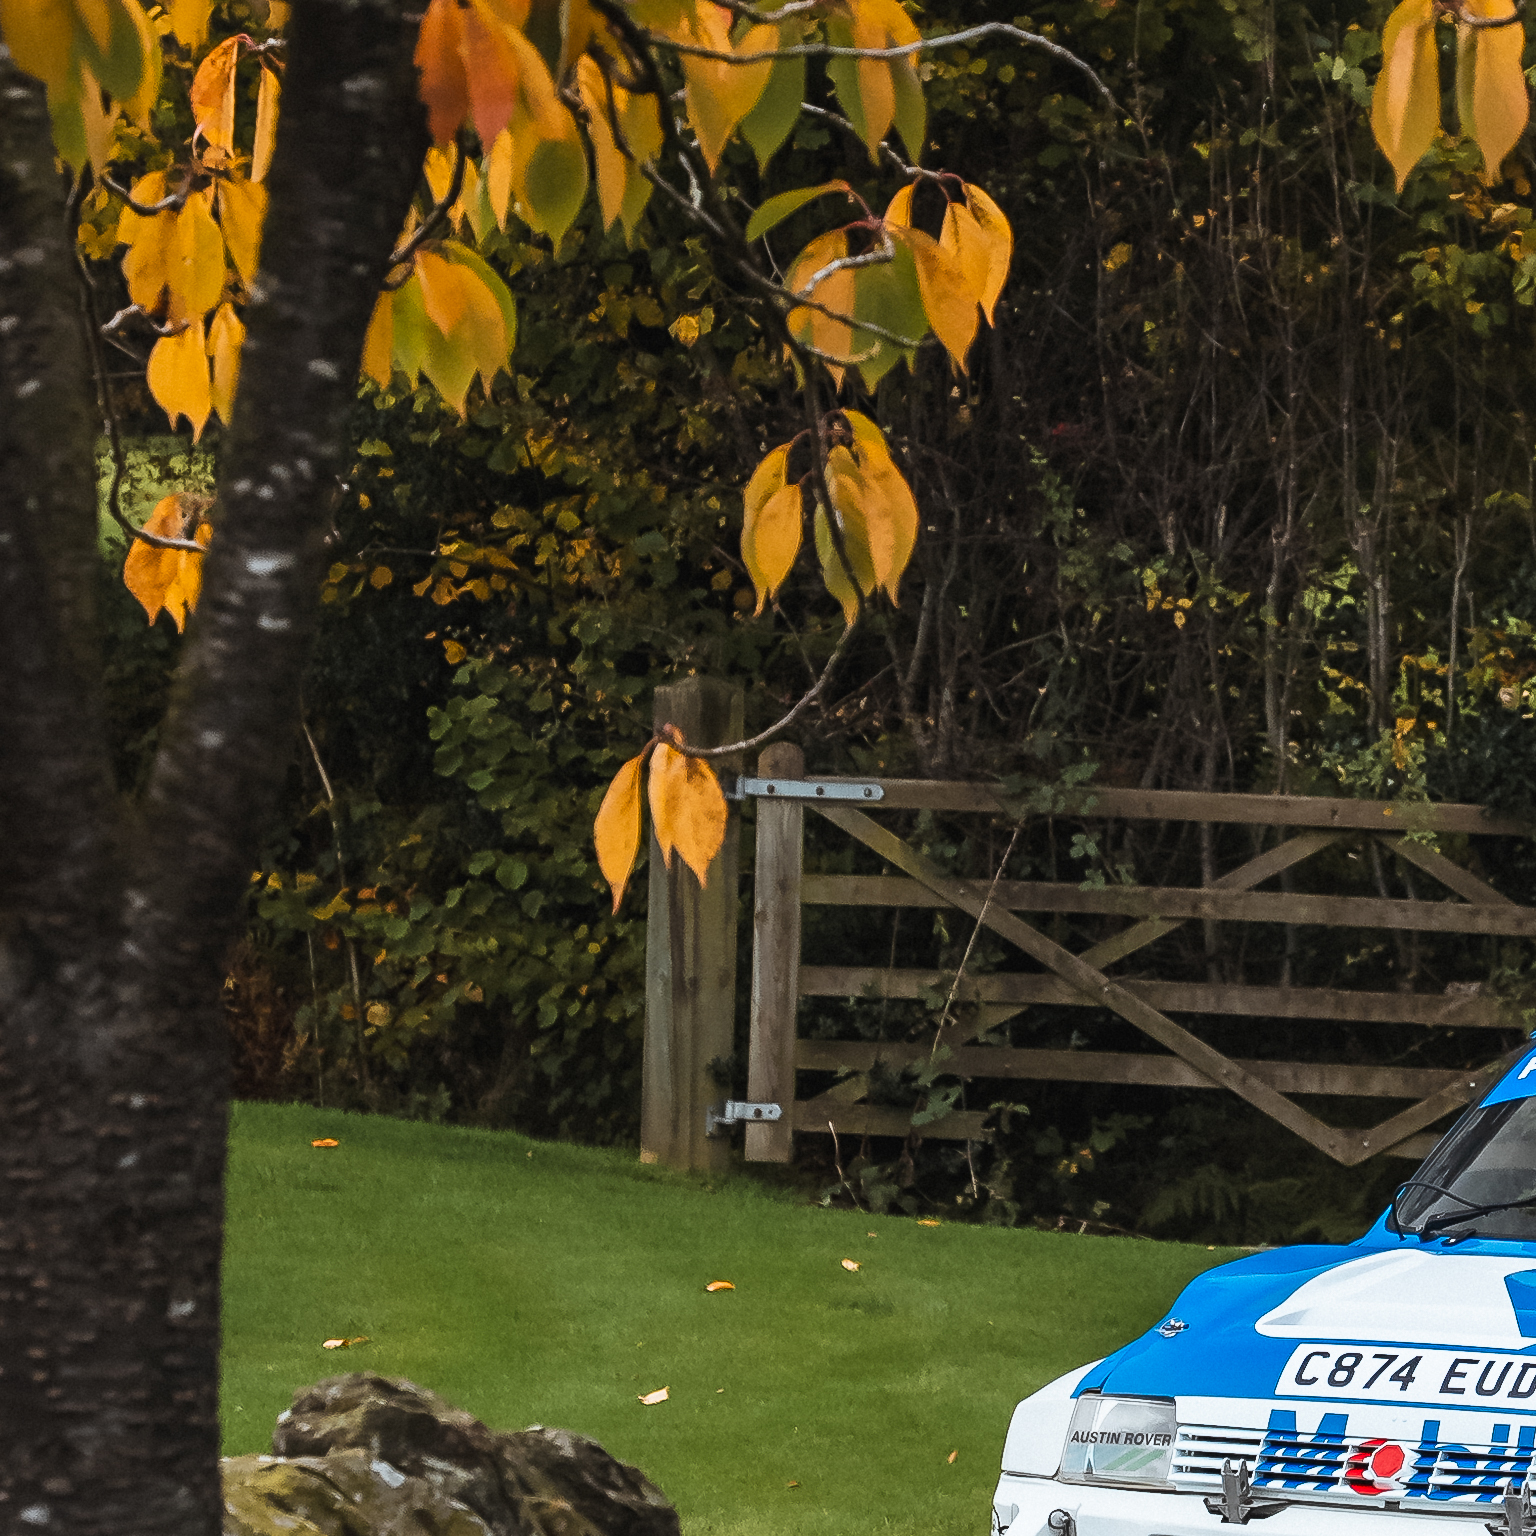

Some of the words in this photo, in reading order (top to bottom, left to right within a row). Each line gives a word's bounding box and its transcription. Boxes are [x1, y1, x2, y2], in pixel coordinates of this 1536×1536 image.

[1295, 1351, 1424, 1392] C874
[1070, 1430, 1121, 1445] AUSTIN
[1123, 1432, 1172, 1447] ROVER
